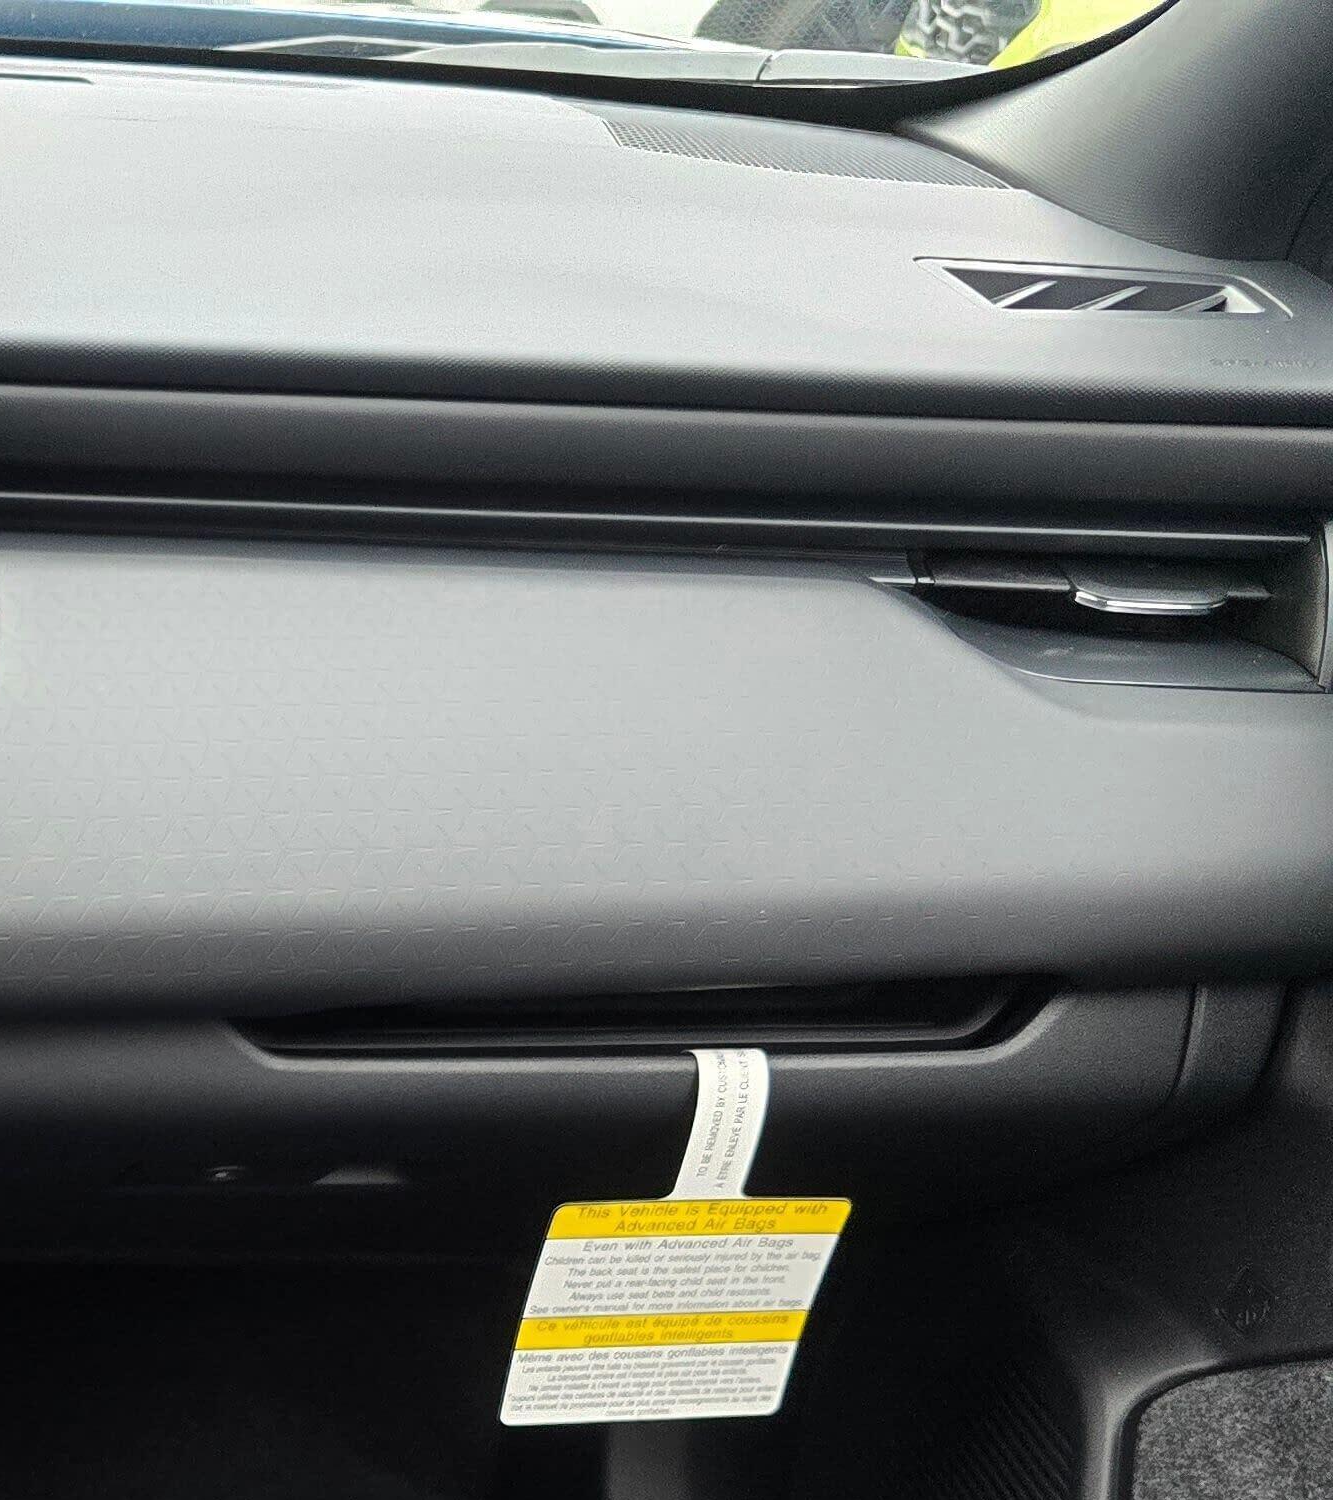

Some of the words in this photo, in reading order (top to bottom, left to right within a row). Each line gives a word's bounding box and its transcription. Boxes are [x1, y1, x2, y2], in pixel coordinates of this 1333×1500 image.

[576, 1206, 611, 1218] This
[620, 1204, 679, 1217] Vehicle
[685, 1203, 699, 1215] is
[707, 1201, 788, 1217] Equipped
[794, 1202, 828, 1215] with
[614, 1219, 696, 1233] Advanced
[703, 1219, 726, 1231] Air
[733, 1218, 777, 1233] Bags
[582, 1241, 617, 1252] Even
[625, 1240, 652, 1250] with
[657, 1238, 727, 1250] Advanced
[733, 1237, 751, 1248] Air
[758, 1237, 794, 1251] Bags
[537, 1321, 557, 1332] Ce
[625, 1318, 647, 1328] est
[705, 1314, 723, 1325] de
[728, 1314, 789, 1326] coussins
[660, 1329, 733, 1343] intelligents
[613, 1349, 663, 1361] coussins
